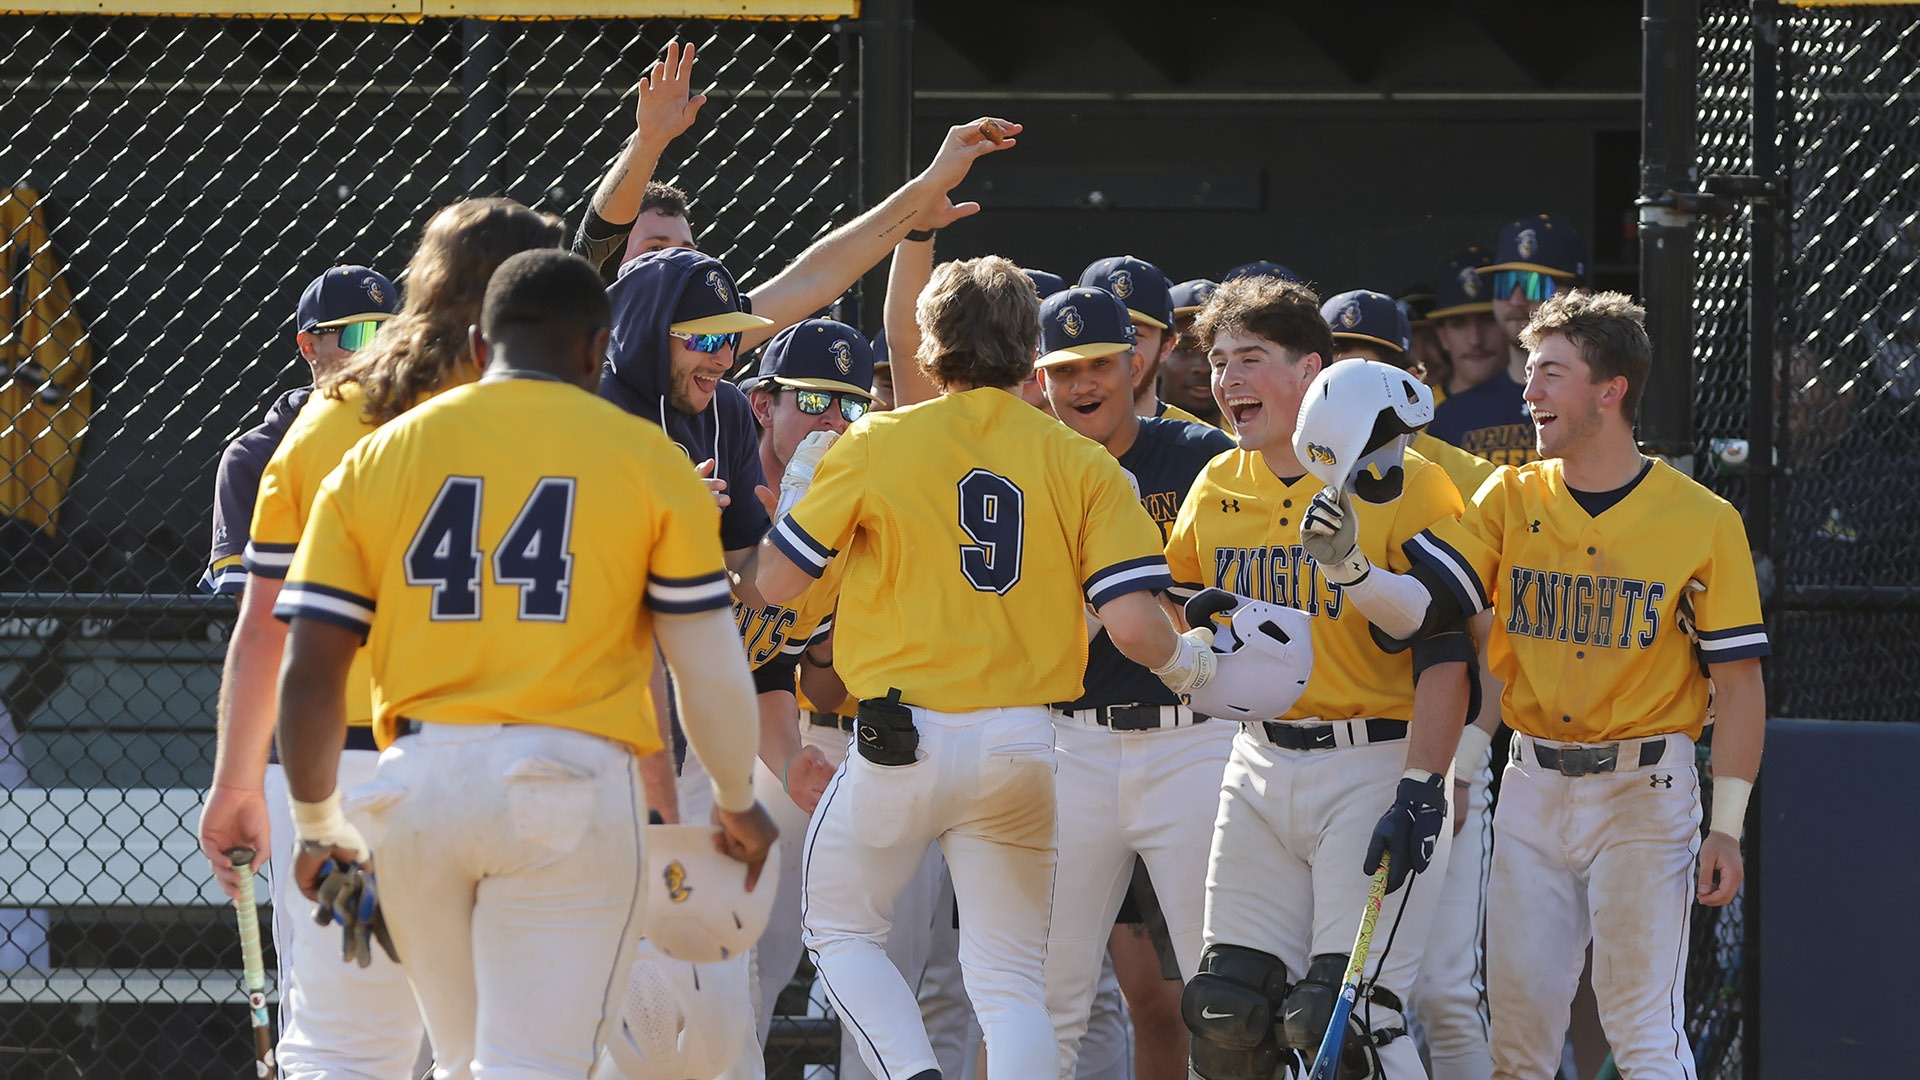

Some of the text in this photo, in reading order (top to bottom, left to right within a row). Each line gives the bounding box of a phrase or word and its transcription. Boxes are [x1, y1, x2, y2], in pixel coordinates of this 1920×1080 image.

[1461, 423, 1538, 453] NEUM
[403, 474, 577, 623] 44
[957, 467, 1025, 597] 9
[1506, 565, 1667, 649] KNIGHTS
